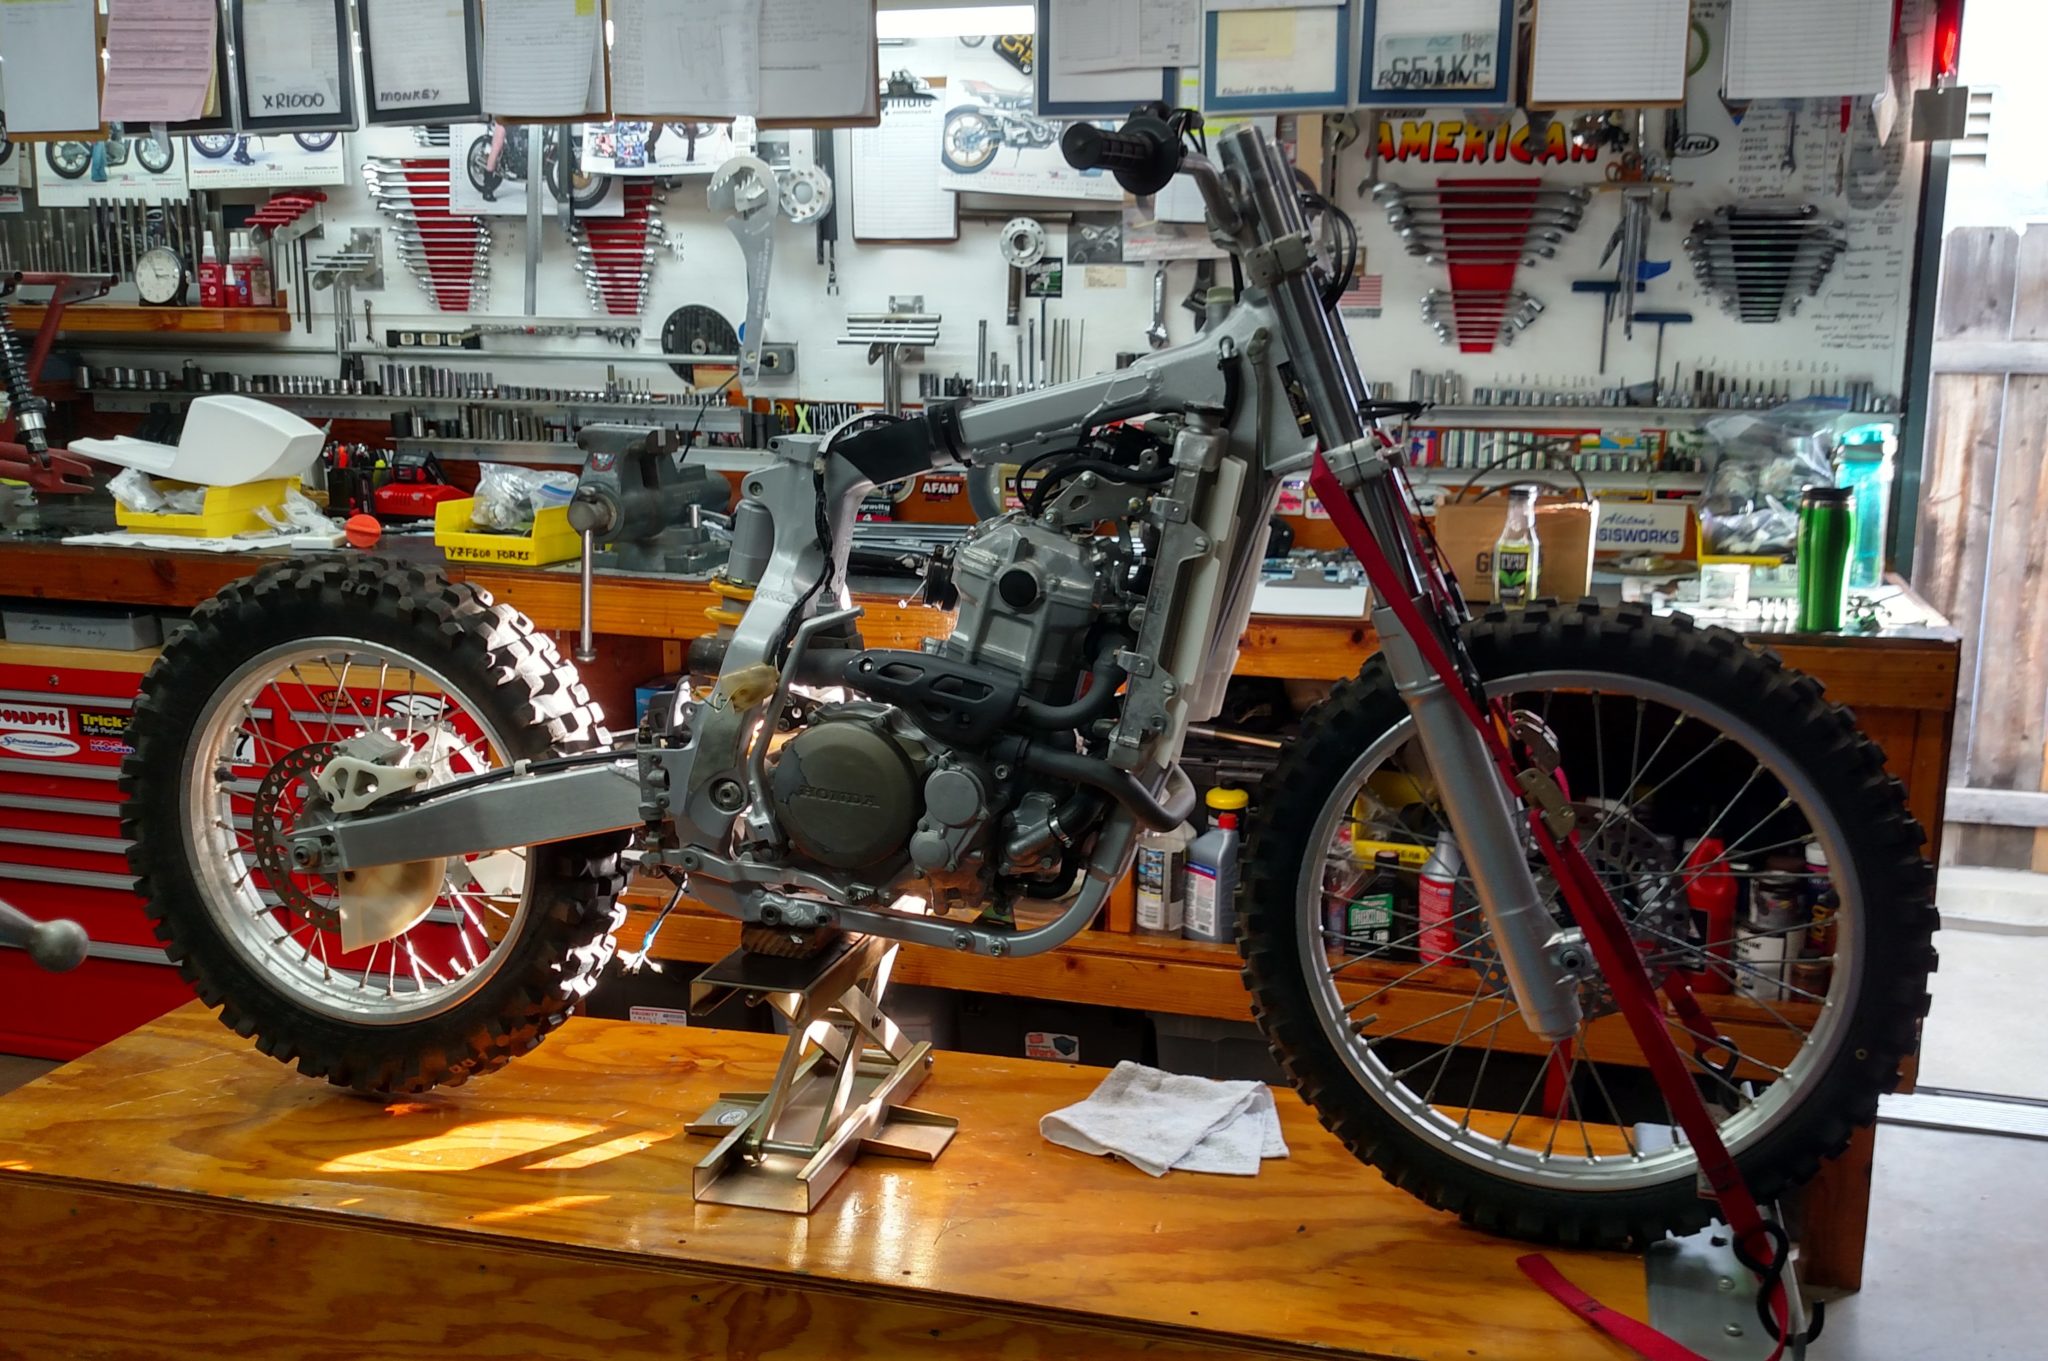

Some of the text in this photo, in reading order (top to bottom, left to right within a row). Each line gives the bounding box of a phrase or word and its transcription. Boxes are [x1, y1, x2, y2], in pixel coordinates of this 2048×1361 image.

[262, 92, 325, 109] XR1000
[380, 89, 440, 102] MONKEY
[921, 482, 960, 495] AFAM
[1602, 512, 1655, 526] Alston's
[799, 784, 880, 809] HONDA
